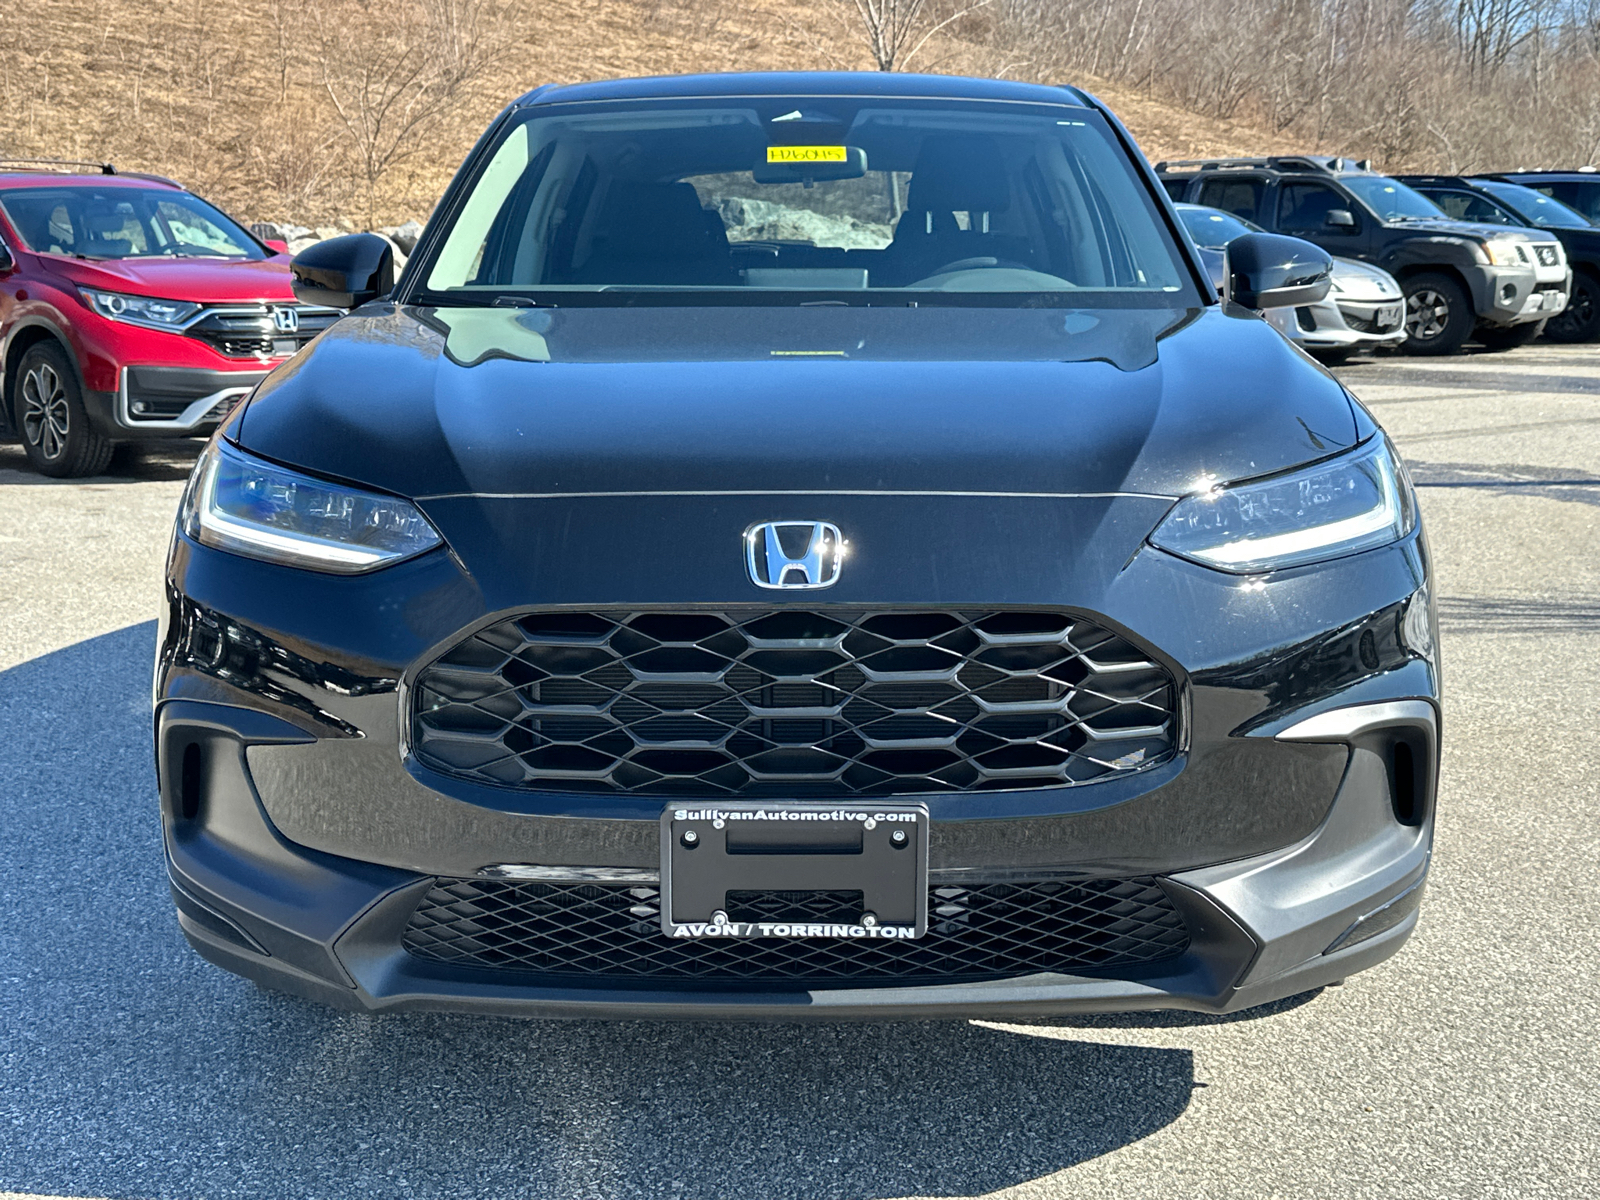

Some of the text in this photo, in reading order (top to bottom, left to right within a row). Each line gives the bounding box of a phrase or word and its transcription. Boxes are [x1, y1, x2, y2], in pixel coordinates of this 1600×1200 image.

[674, 809, 916, 822] SullivanAutomotive.com
[673, 924, 739, 937] AVON
[759, 925, 915, 939] TORRINGTON
